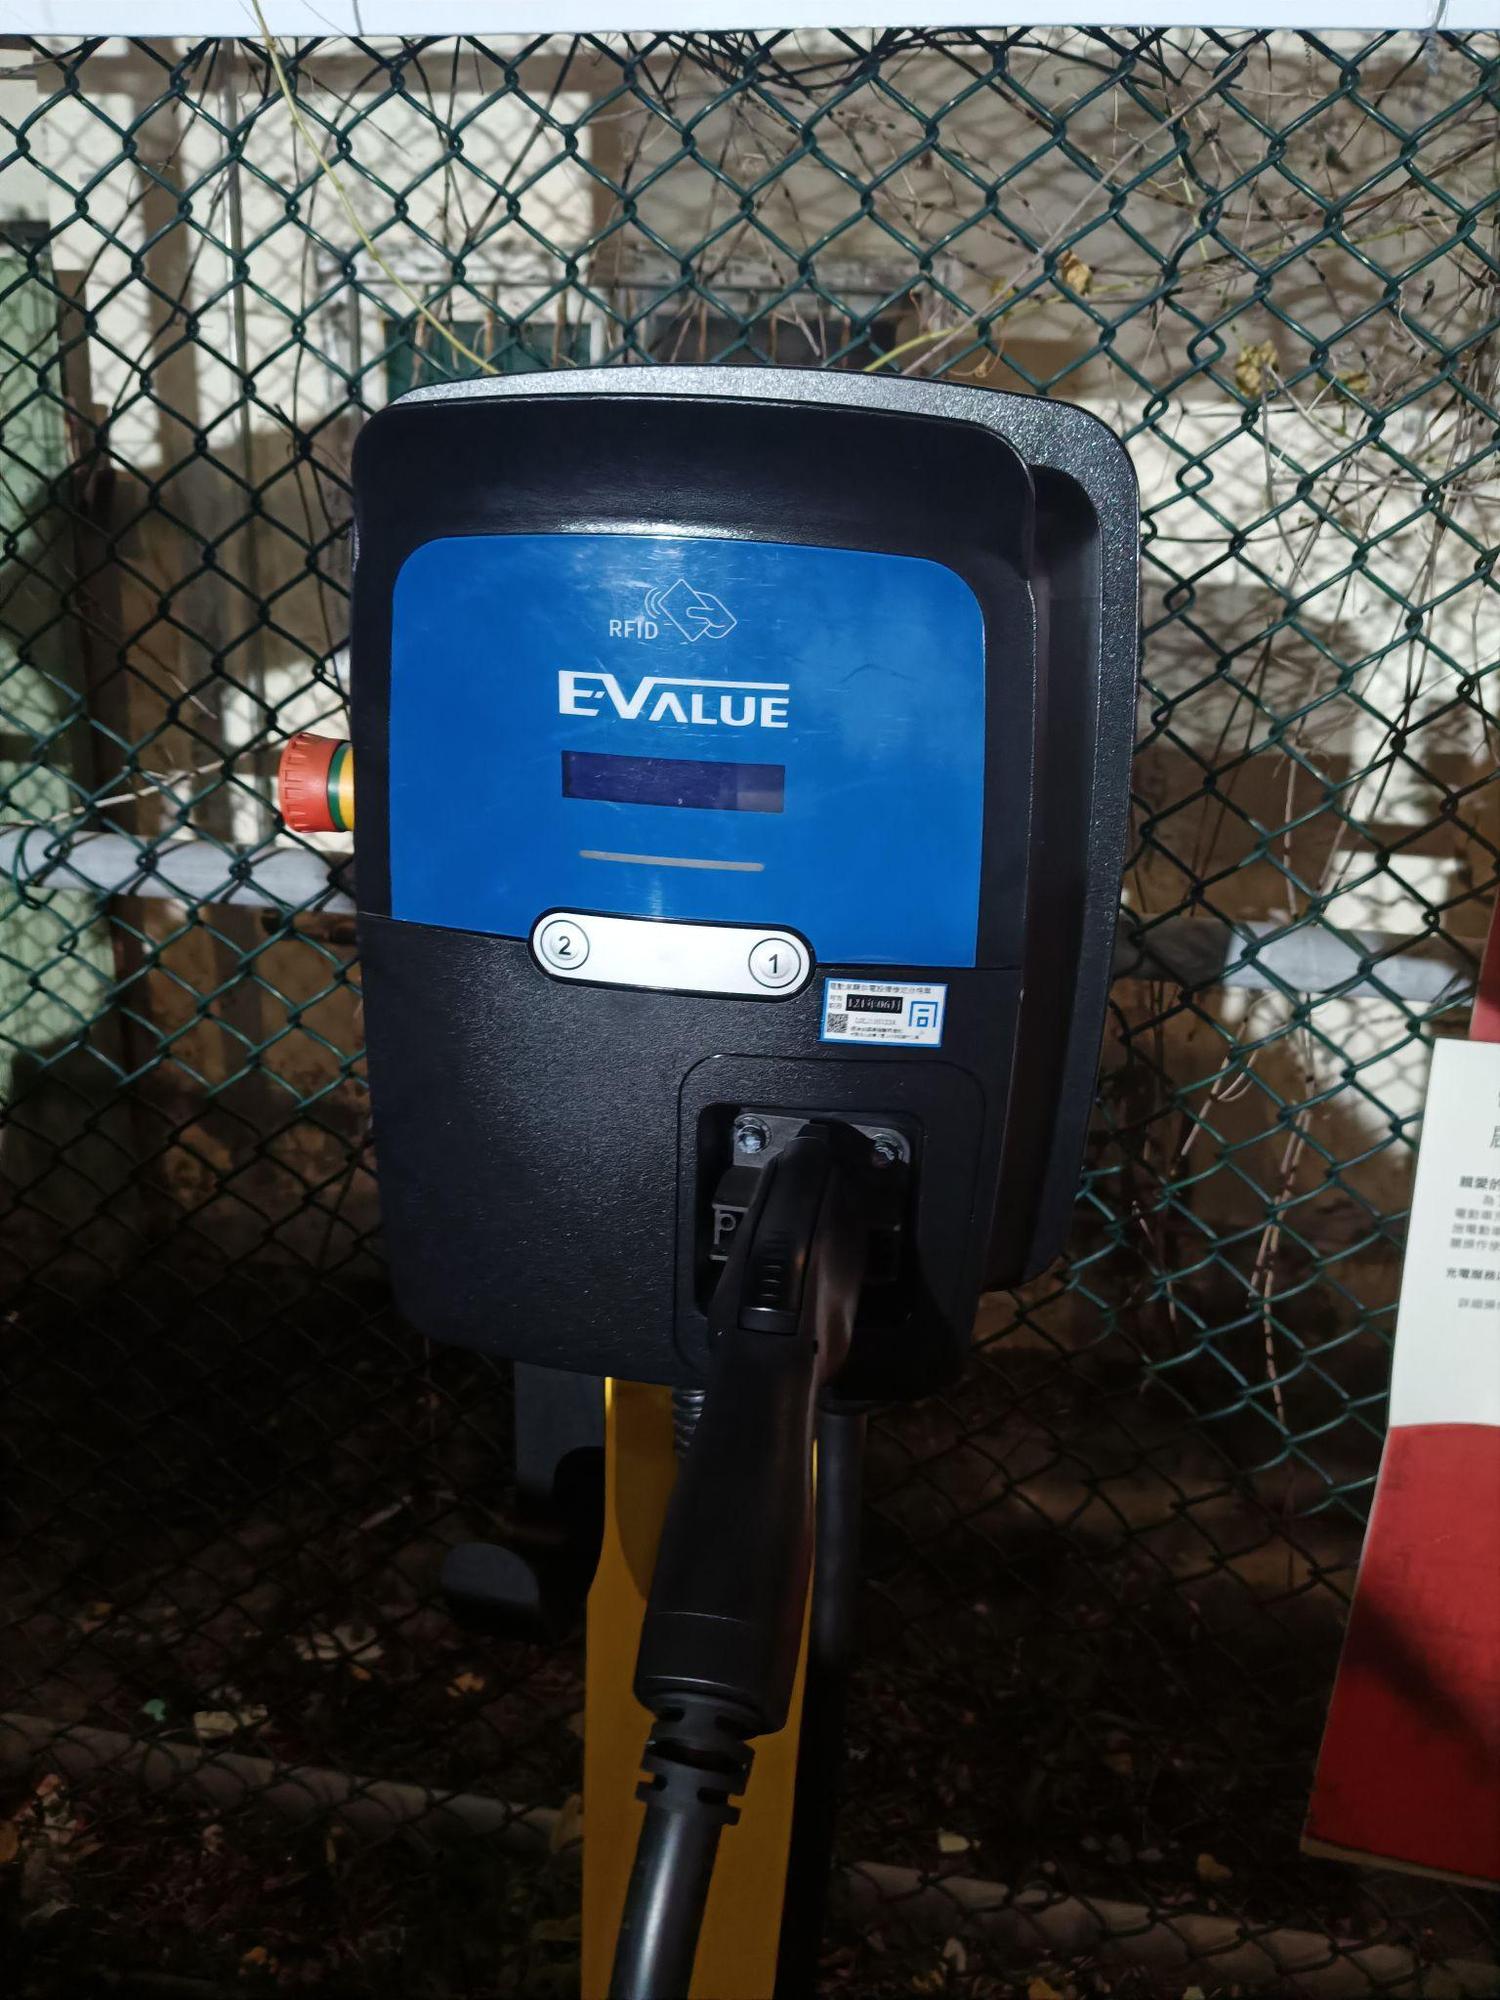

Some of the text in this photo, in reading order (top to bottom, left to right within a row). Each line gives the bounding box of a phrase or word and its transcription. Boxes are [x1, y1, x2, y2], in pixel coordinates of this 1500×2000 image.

[609, 619, 659, 640] RFID
[558, 935, 571, 955] 2
[768, 952, 778, 974] 1
